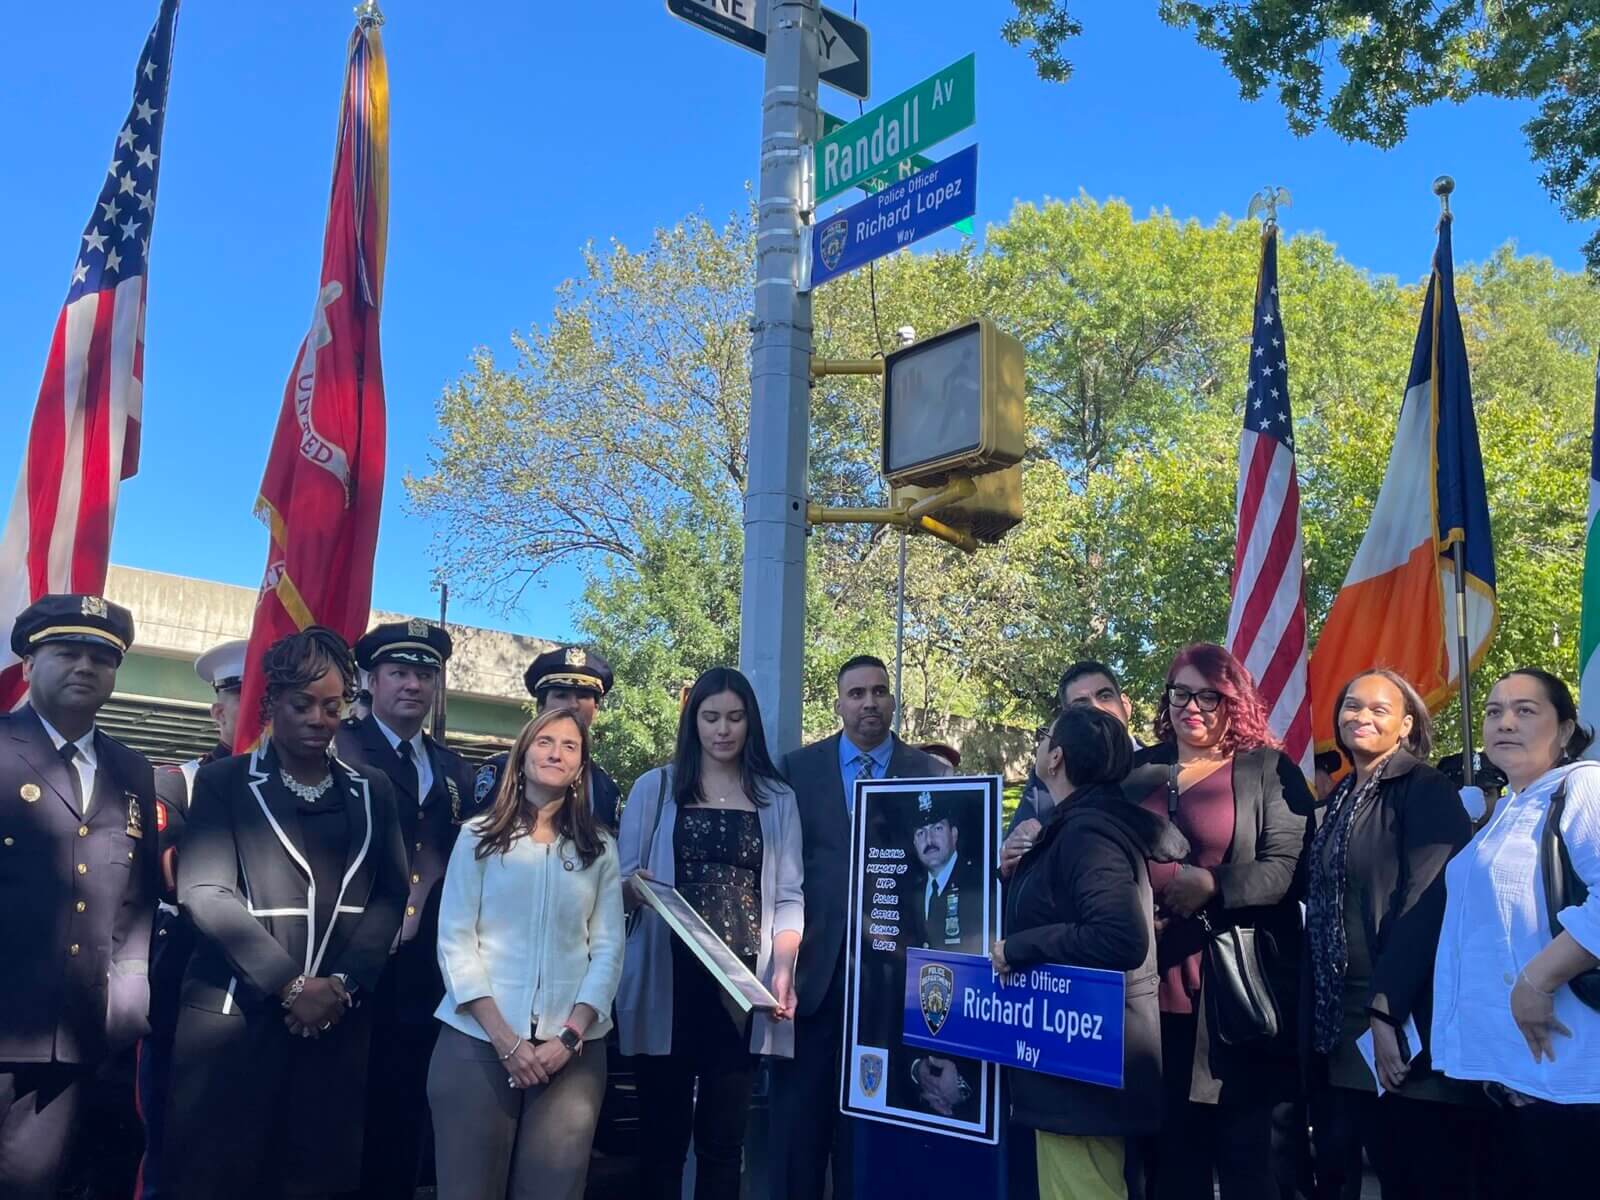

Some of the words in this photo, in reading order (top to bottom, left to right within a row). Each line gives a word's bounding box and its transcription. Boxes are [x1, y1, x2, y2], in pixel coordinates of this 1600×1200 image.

[823, 94, 919, 192] Randall
[931, 78, 954, 111] Av
[856, 198, 911, 244] Richard
[916, 178, 963, 214] Lopez
[878, 187, 906, 209] Police
[908, 169, 940, 194] Officer
[896, 228, 916, 244] Way
[298, 372, 333, 463] UNTED
[991, 967, 1027, 988] Plice
[1031, 970, 1072, 995] Officer
[963, 987, 1034, 1029] Richard
[1042, 998, 1103, 1043] Lopez
[1016, 1039, 1041, 1069] Way
